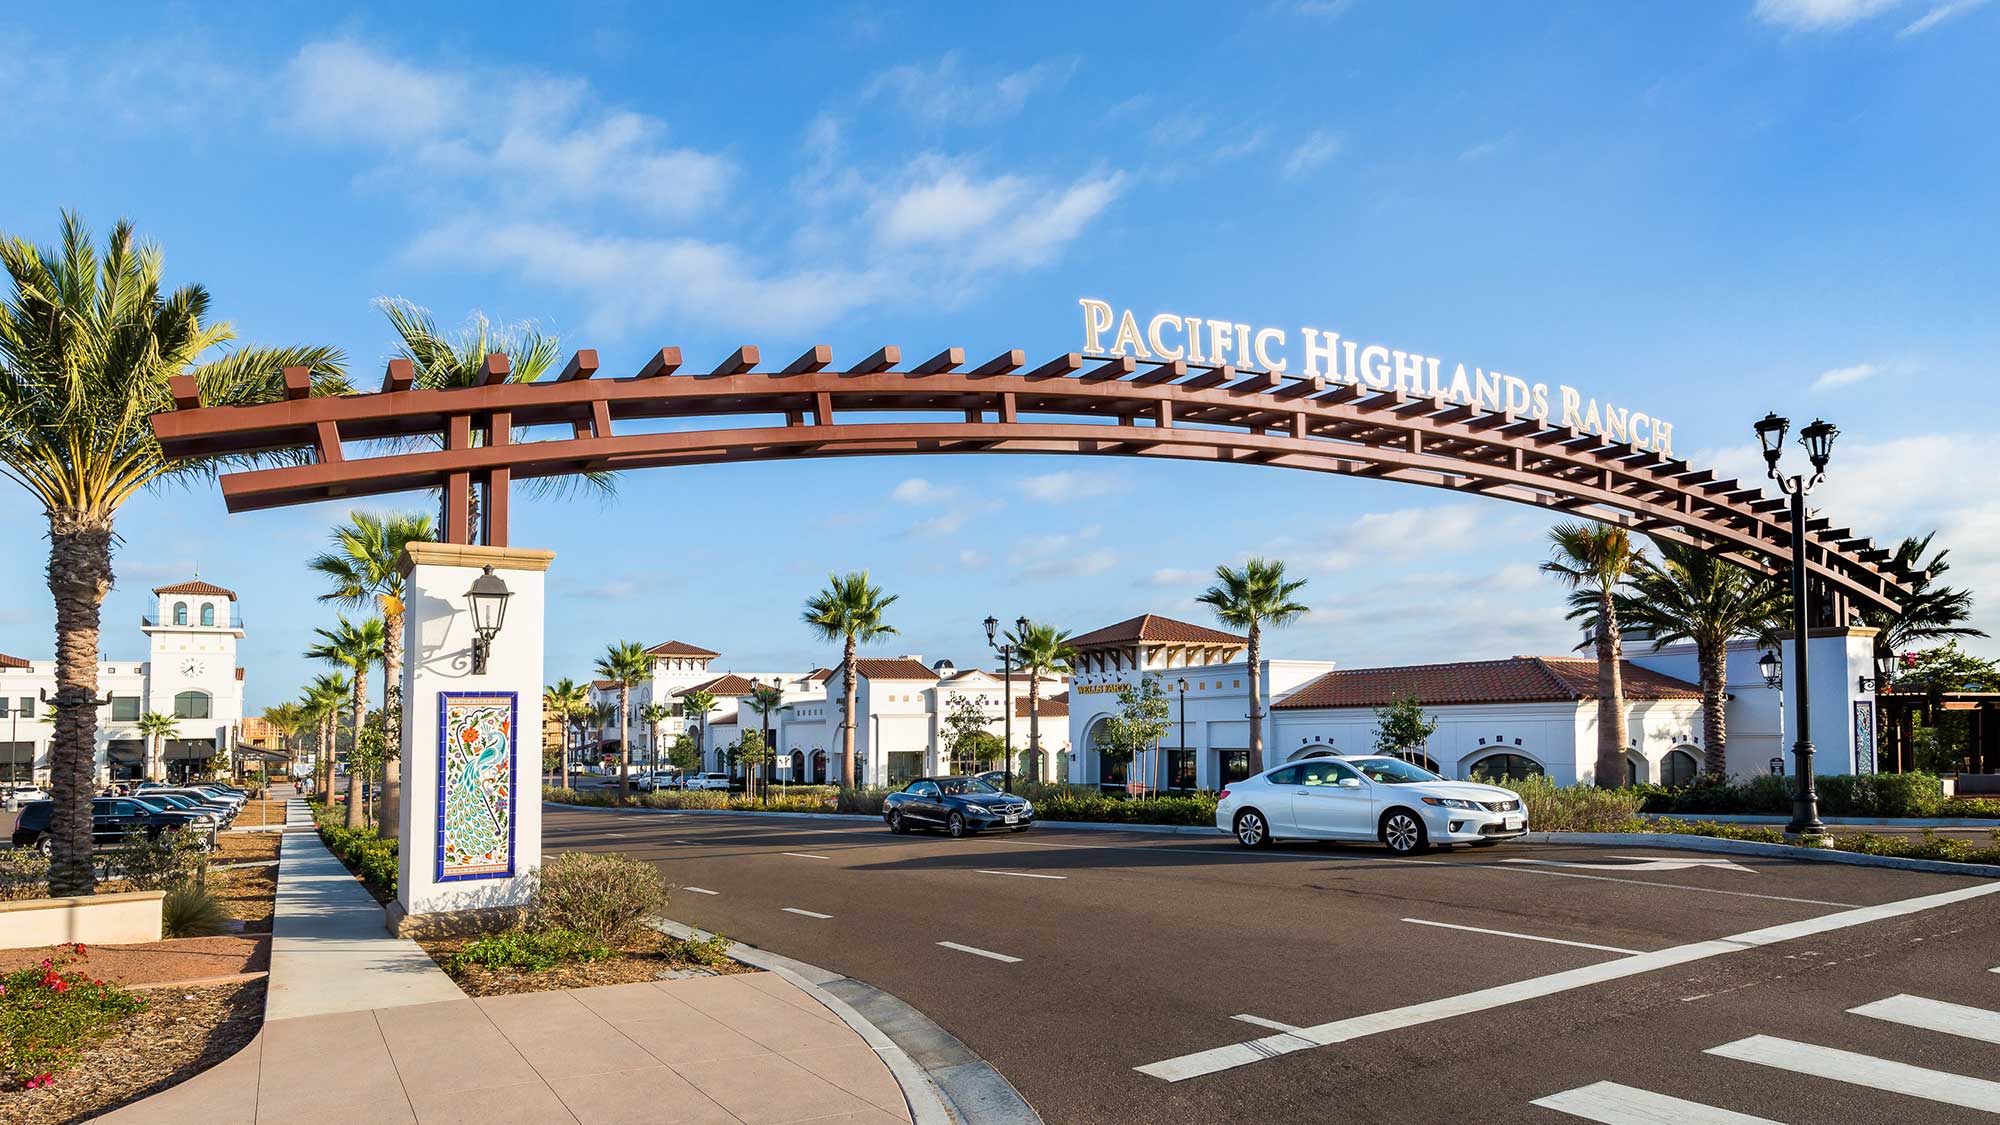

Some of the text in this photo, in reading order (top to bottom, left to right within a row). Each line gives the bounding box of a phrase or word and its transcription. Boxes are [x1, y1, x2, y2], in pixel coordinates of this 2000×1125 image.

[1080, 299, 1673, 454] PACIFIC HIGHLANDS RANCH
[1077, 685, 1103, 695] WELLS
